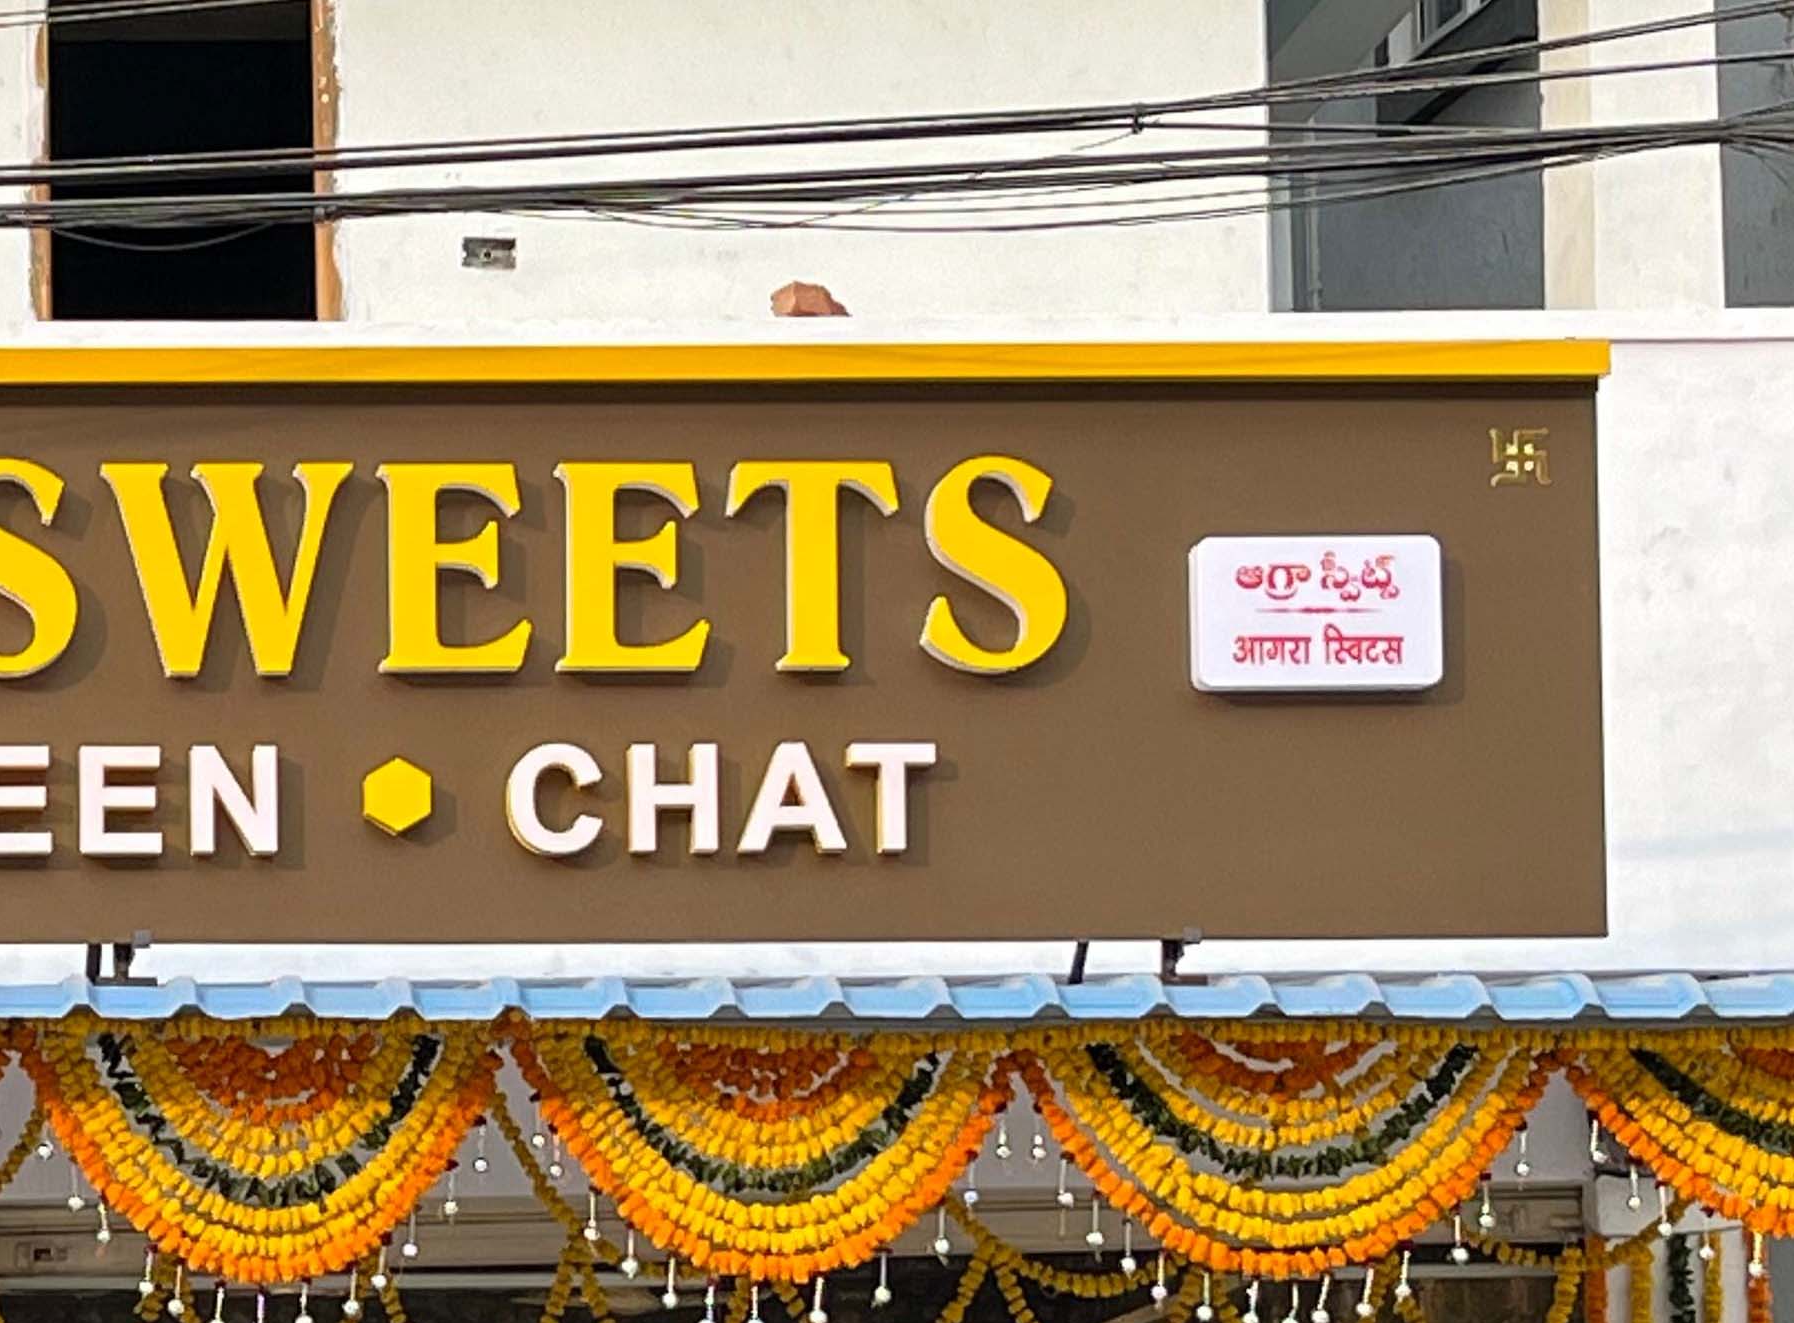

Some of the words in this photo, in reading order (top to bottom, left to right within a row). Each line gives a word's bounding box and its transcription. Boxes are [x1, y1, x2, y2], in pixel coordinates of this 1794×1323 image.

[1235, 563, 1312, 601] ఆగ్రా
[1232, 633, 1312, 666] आगरा
[1322, 622, 1405, 666] स्विटस
[505, 740, 937, 858] CHAT
